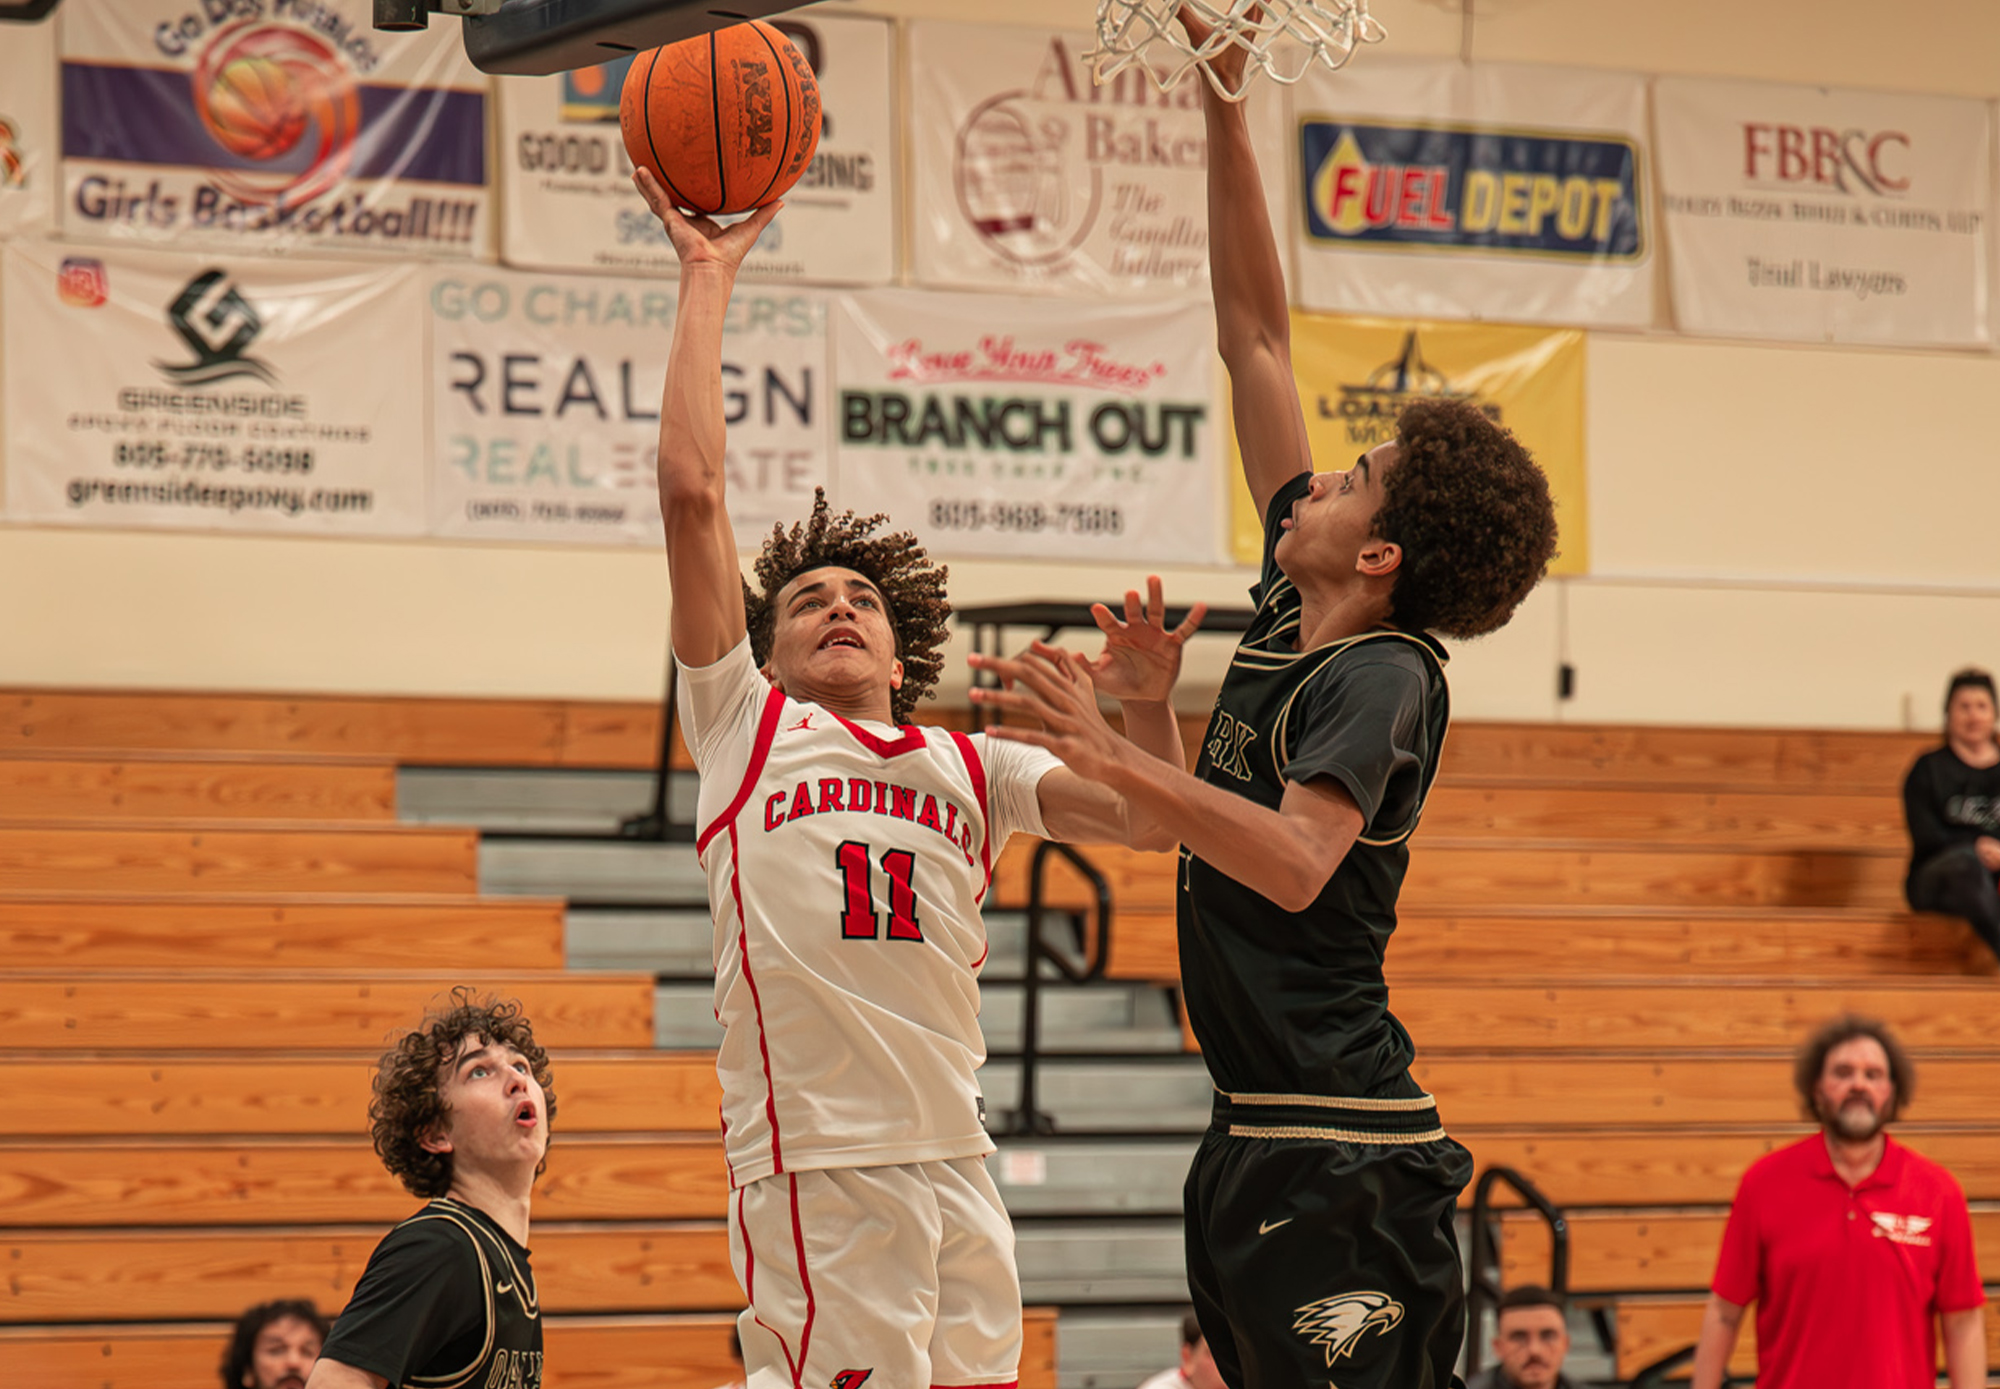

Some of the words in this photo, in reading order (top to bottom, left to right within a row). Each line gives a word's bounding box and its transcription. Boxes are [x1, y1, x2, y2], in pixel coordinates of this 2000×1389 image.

[155, 13, 201, 56] Go
[740, 59, 773, 157] NCAA
[517, 131, 610, 173] GOOD
[75, 175, 178, 224] Girls
[194, 184, 478, 244] Basketball!!!
[1328, 163, 1456, 231] FUEL
[1462, 170, 1623, 241] DEPOT
[430, 278, 510, 323] GO
[523, 282, 828, 338] CHARERS!
[1746, 256, 1803, 288] Trial
[1808, 258, 1909, 300] Lawyers
[886, 337, 974, 381] Love
[978, 334, 1057, 372] Your
[118, 387, 308, 417] GREENSIDE
[449, 351, 814, 427] REALGN
[840, 389, 1073, 453] BRANCH
[1089, 400, 1207, 459] OUT
[449, 434, 597, 488] REAL
[611, 443, 815, 494] ESATE
[67, 477, 374, 518] greensideepoxy.com
[1207, 709, 1258, 782] RK
[835, 839, 925, 943] 11
